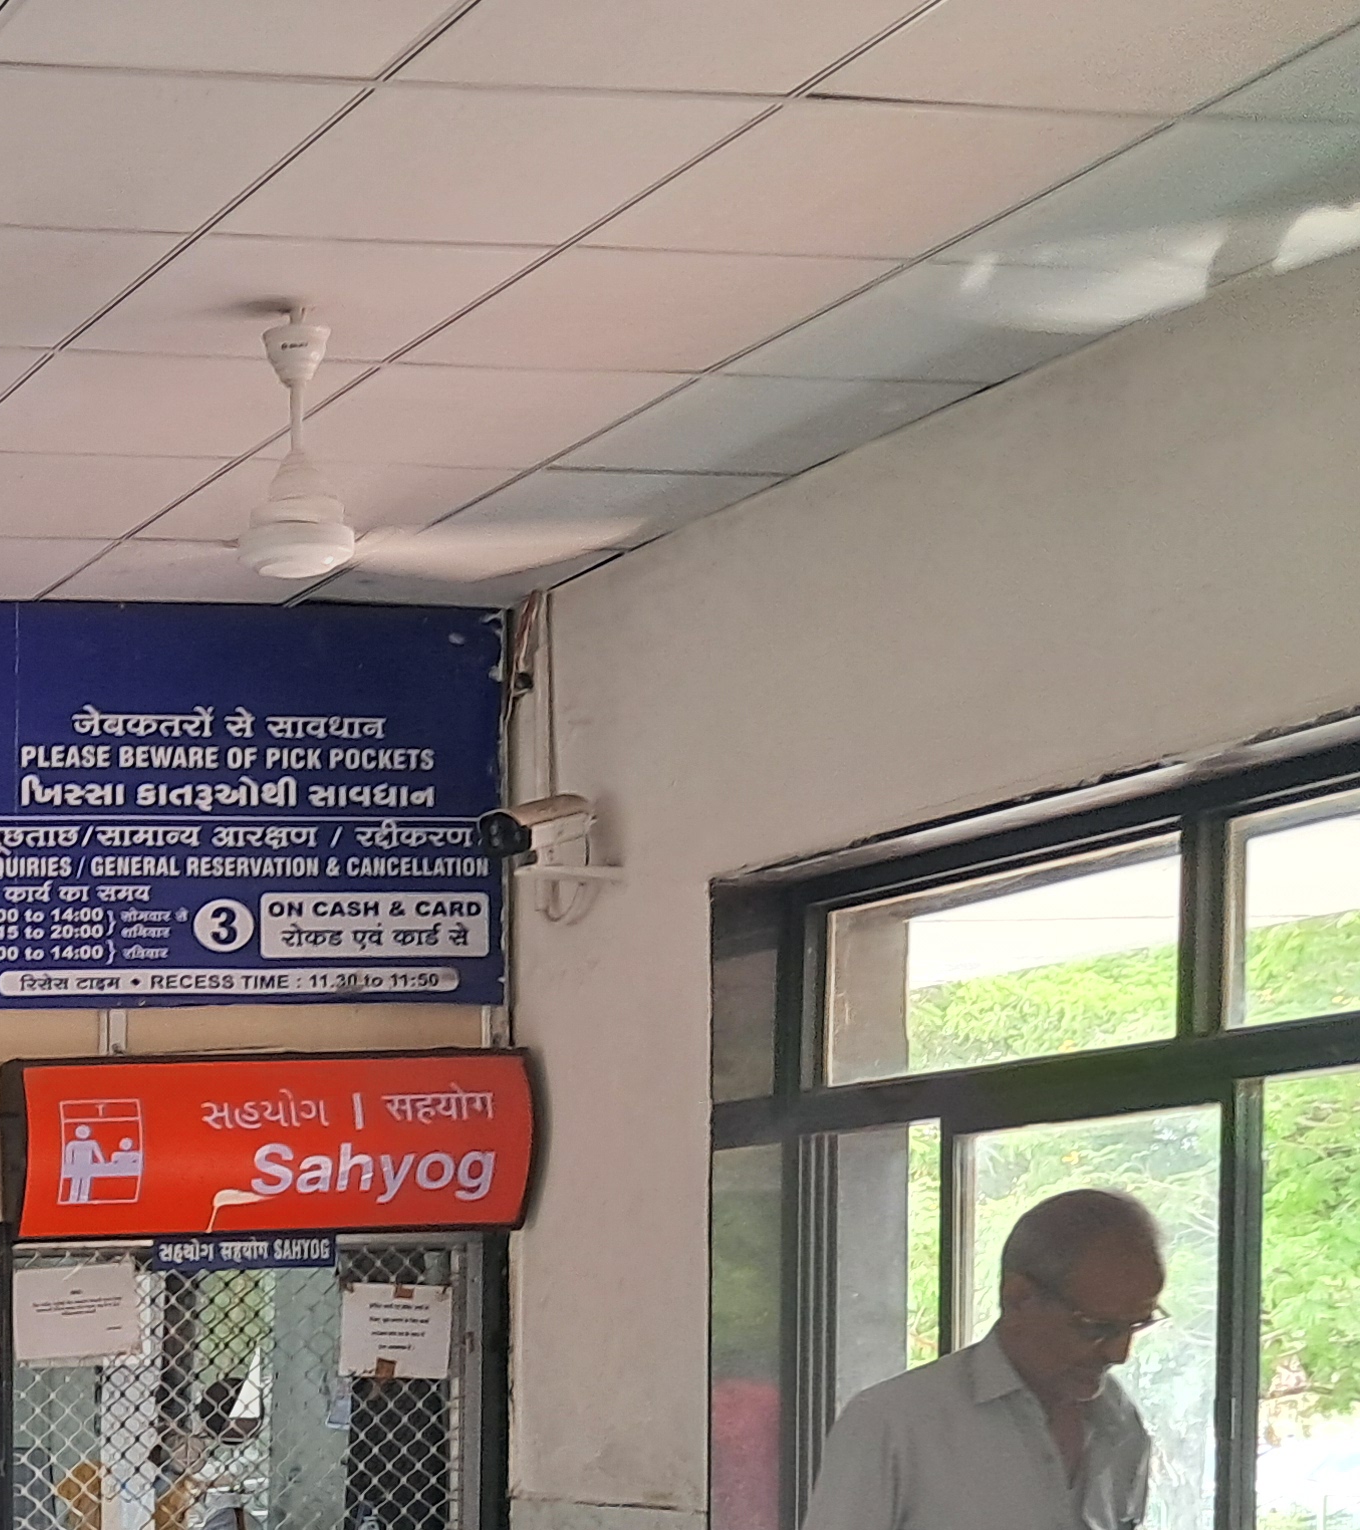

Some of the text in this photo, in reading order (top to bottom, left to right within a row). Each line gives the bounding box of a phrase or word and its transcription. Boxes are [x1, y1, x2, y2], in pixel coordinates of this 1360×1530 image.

[71, 704, 387, 739] जेबकतरों से सावधान
[20, 744, 435, 771] PLEASE BEWARE OF PICK POCKETS
[90, 855, 181, 877] GENERAL
[186, 856, 319, 877] RESERVATION
[325, 856, 341, 877] &
[346, 856, 489, 877] CANCELLATION
[210, 906, 238, 946] 3
[200, 1082, 493, 1130] સહયોગ सहयोग
[248, 1142, 495, 1203] Sahyog
[158, 1236, 330, 1264] સહયોગ सहयोग SAHYOG
